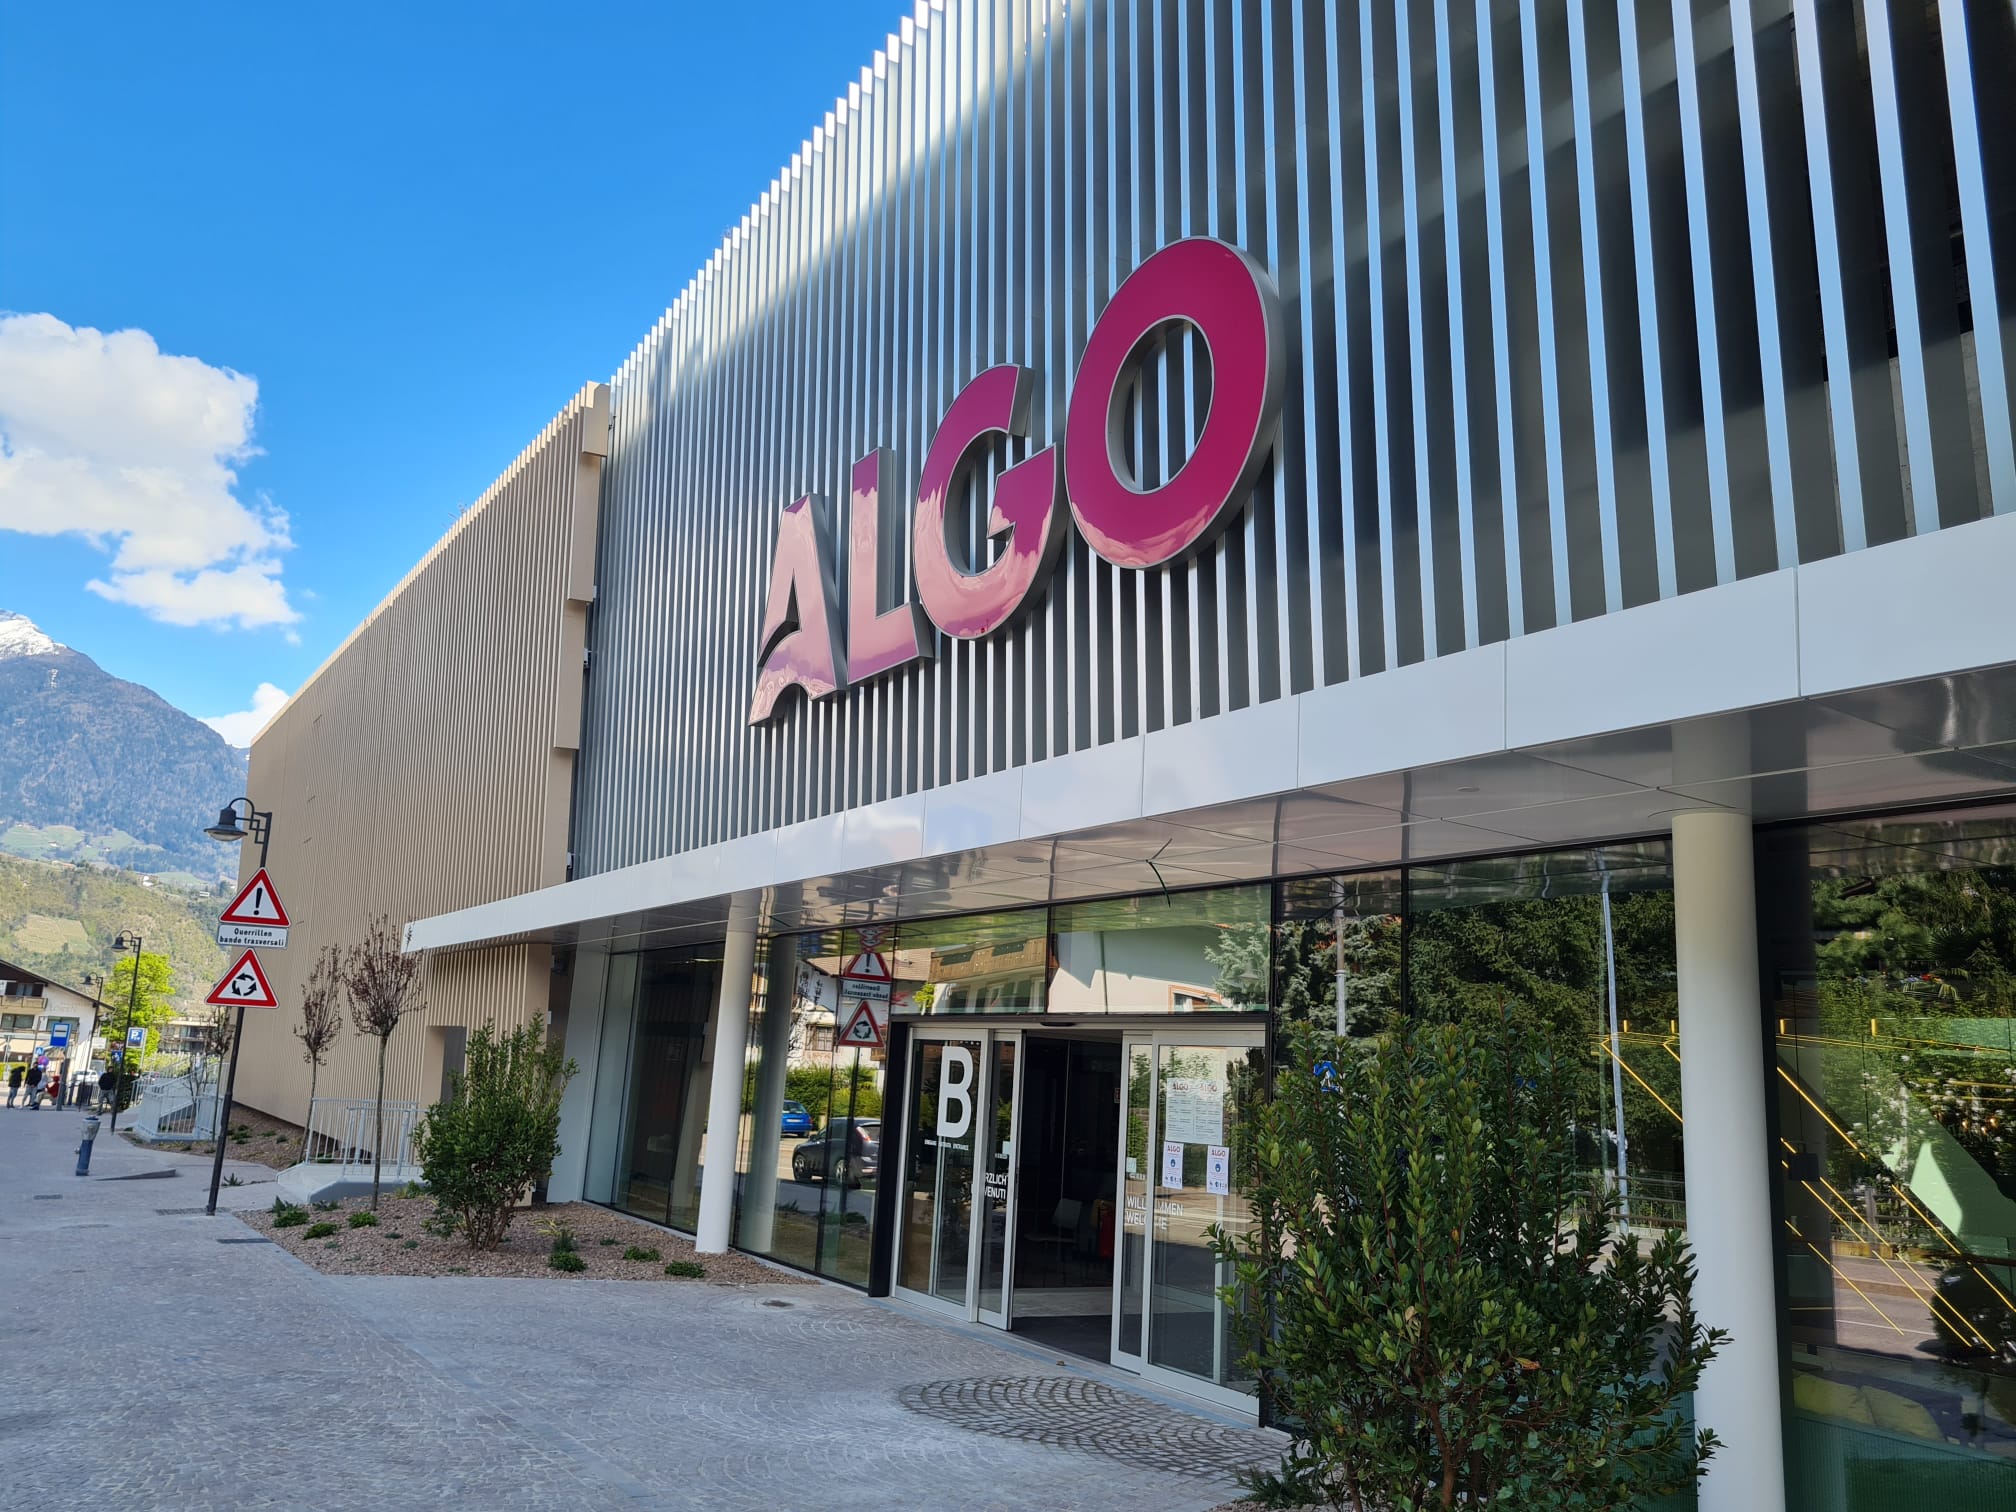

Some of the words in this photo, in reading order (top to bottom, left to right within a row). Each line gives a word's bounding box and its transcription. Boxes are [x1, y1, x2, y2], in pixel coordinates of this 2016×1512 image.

[748, 235, 1282, 727] ALGO
[244, 937, 284, 946] trasversali
[936, 1046, 974, 1139] B
[1167, 1144, 1181, 1153] ALGO
[1211, 1149, 1226, 1157] ALGO
[985, 1172, 1007, 1186] RZLICH
[1126, 1195, 1183, 1216] WILLMMEN
